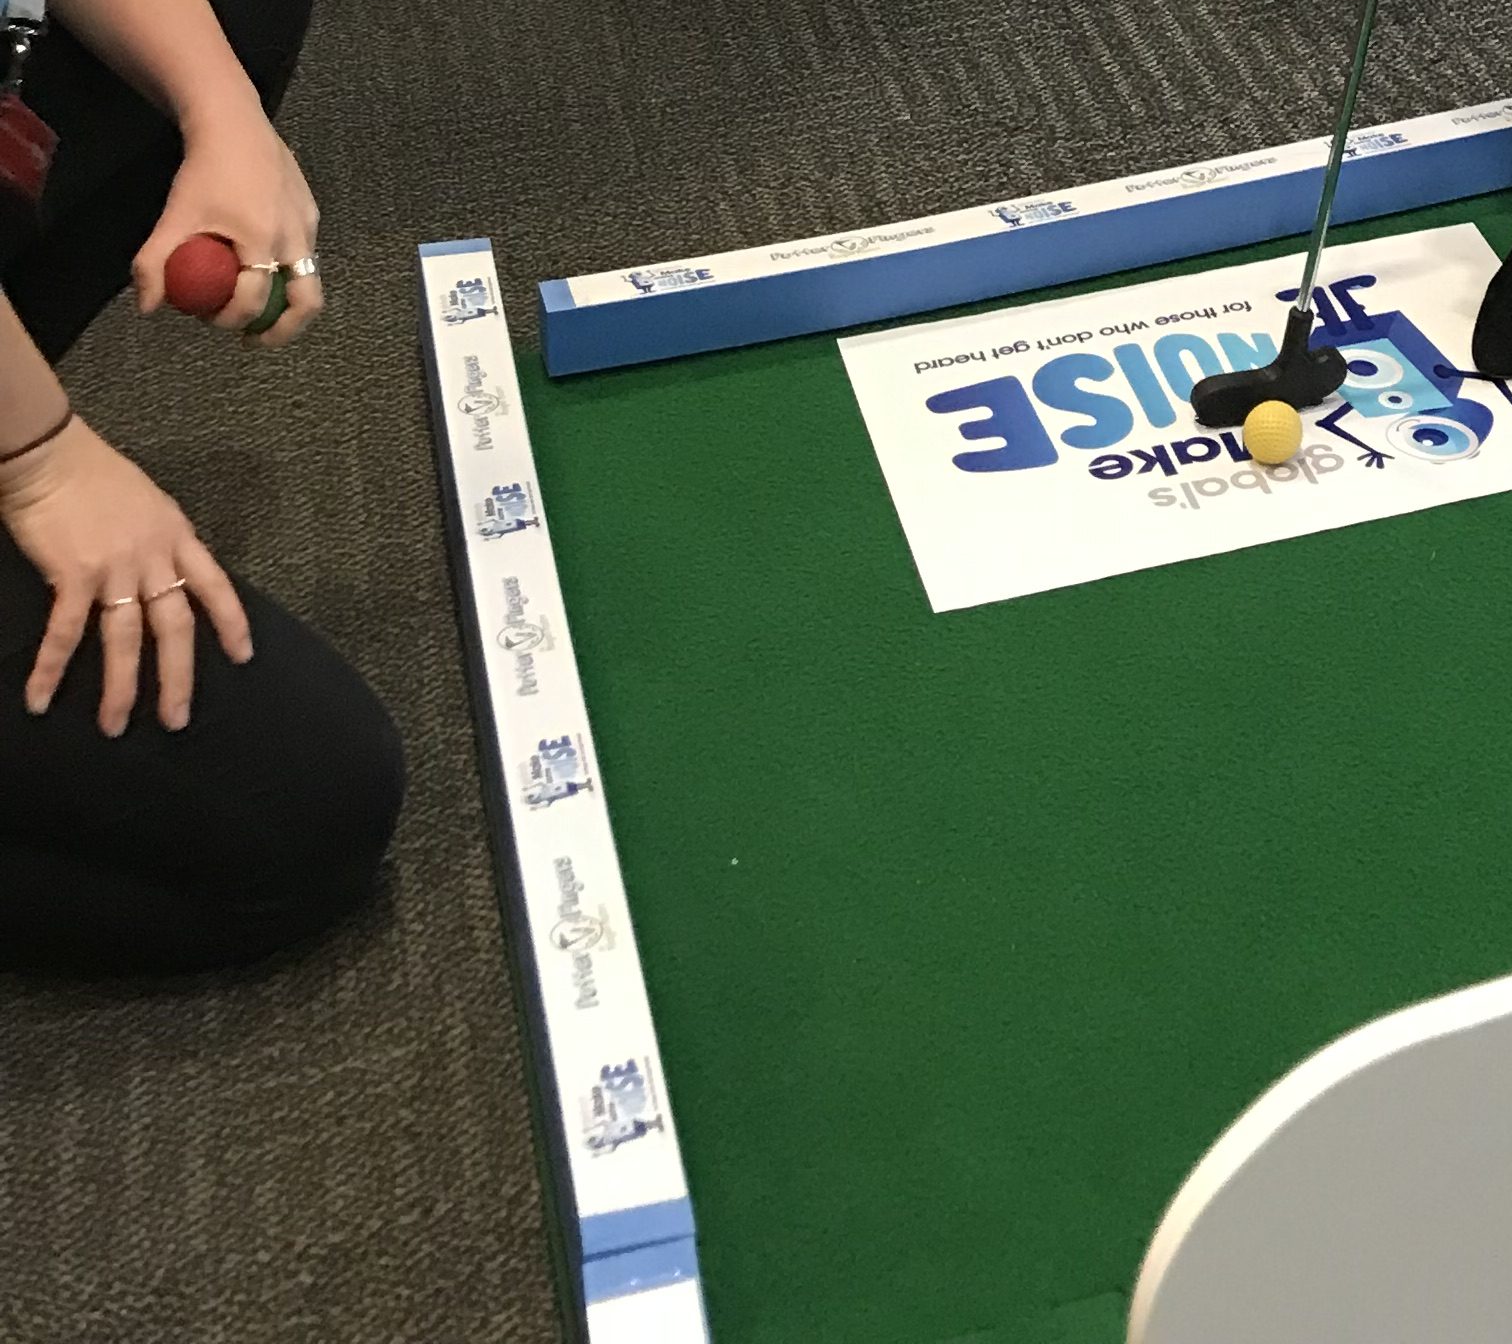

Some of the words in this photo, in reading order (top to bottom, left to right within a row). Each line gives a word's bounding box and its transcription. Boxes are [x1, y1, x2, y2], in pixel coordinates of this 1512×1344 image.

[1155, 306, 1218, 326] those
[1222, 300, 1253, 317] for
[1099, 320, 1149, 338] who
[994, 340, 1031, 360] get
[1037, 330, 1094, 351] don't
[914, 351, 987, 374] heard
